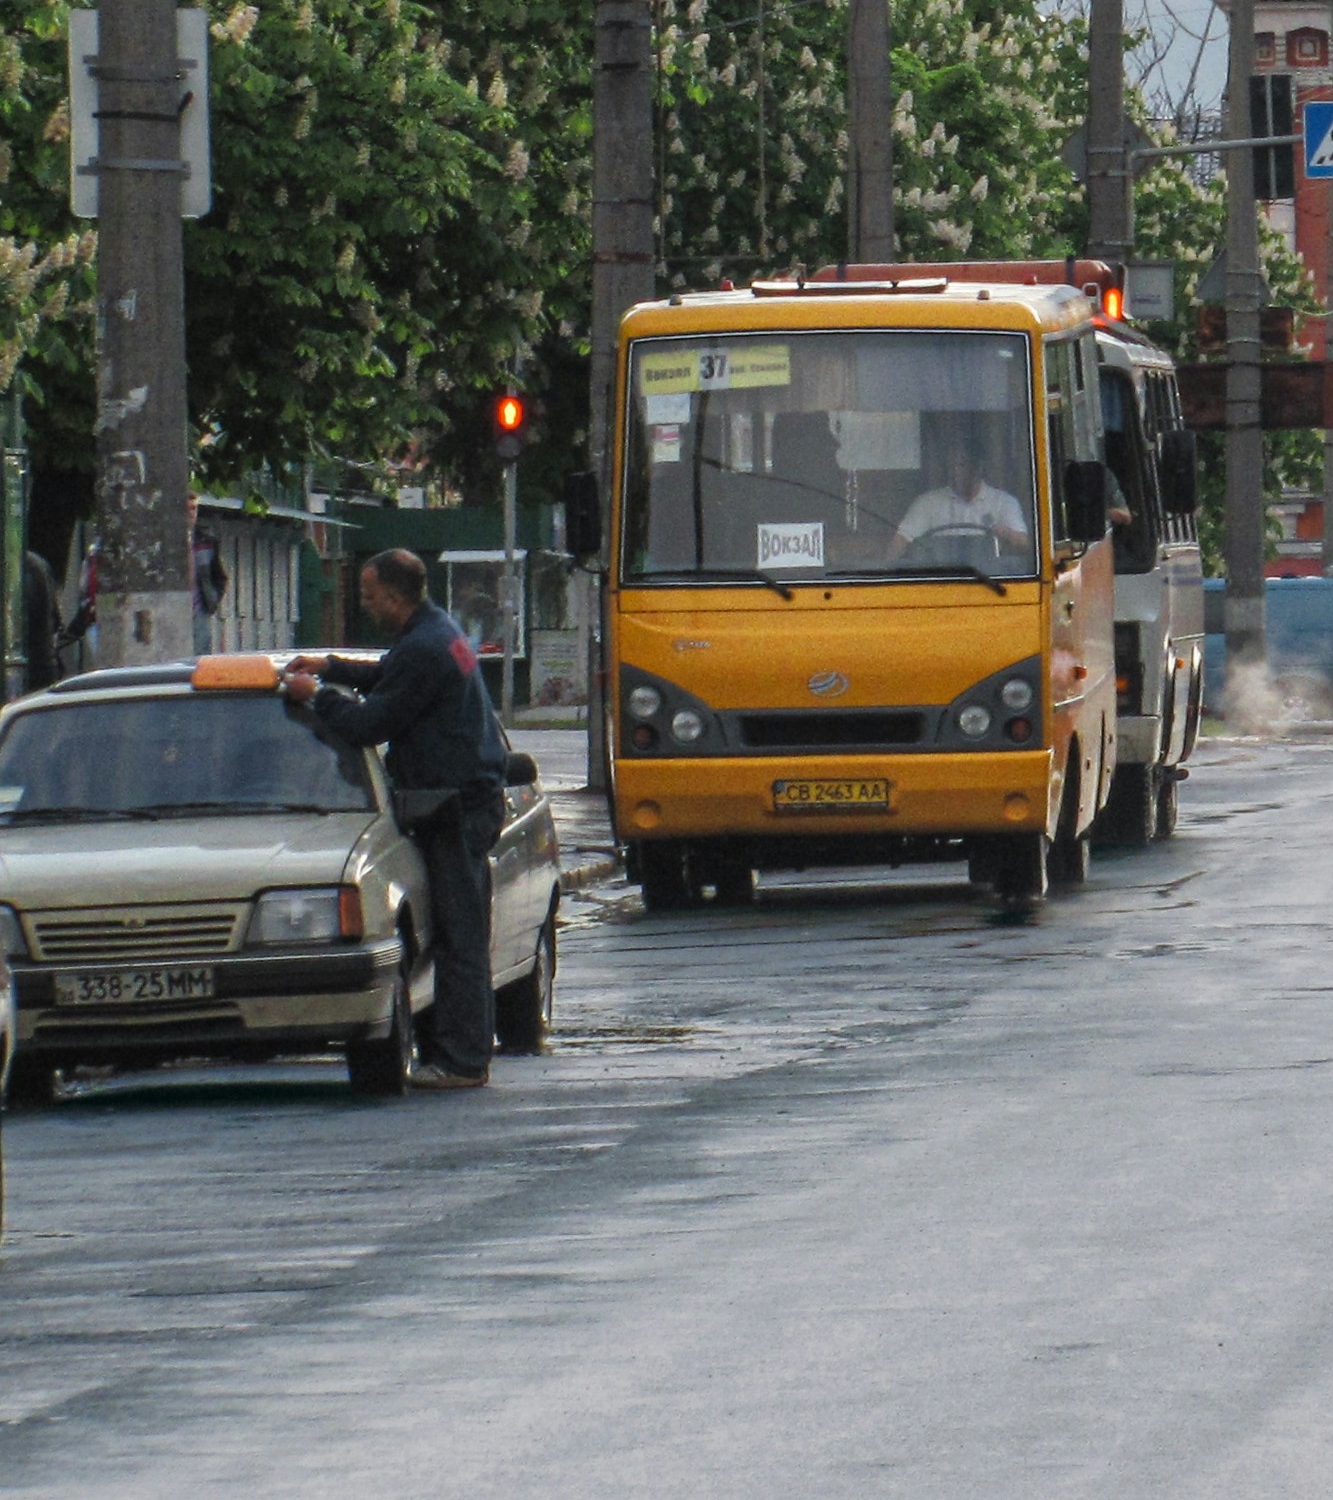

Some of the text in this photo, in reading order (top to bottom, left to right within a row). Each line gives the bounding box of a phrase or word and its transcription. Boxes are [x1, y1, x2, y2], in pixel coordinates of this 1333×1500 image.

[701, 354, 728, 380] 37
[761, 528, 821, 562] ВОКЗАЛ
[786, 783, 881, 801] CB 2463 AA
